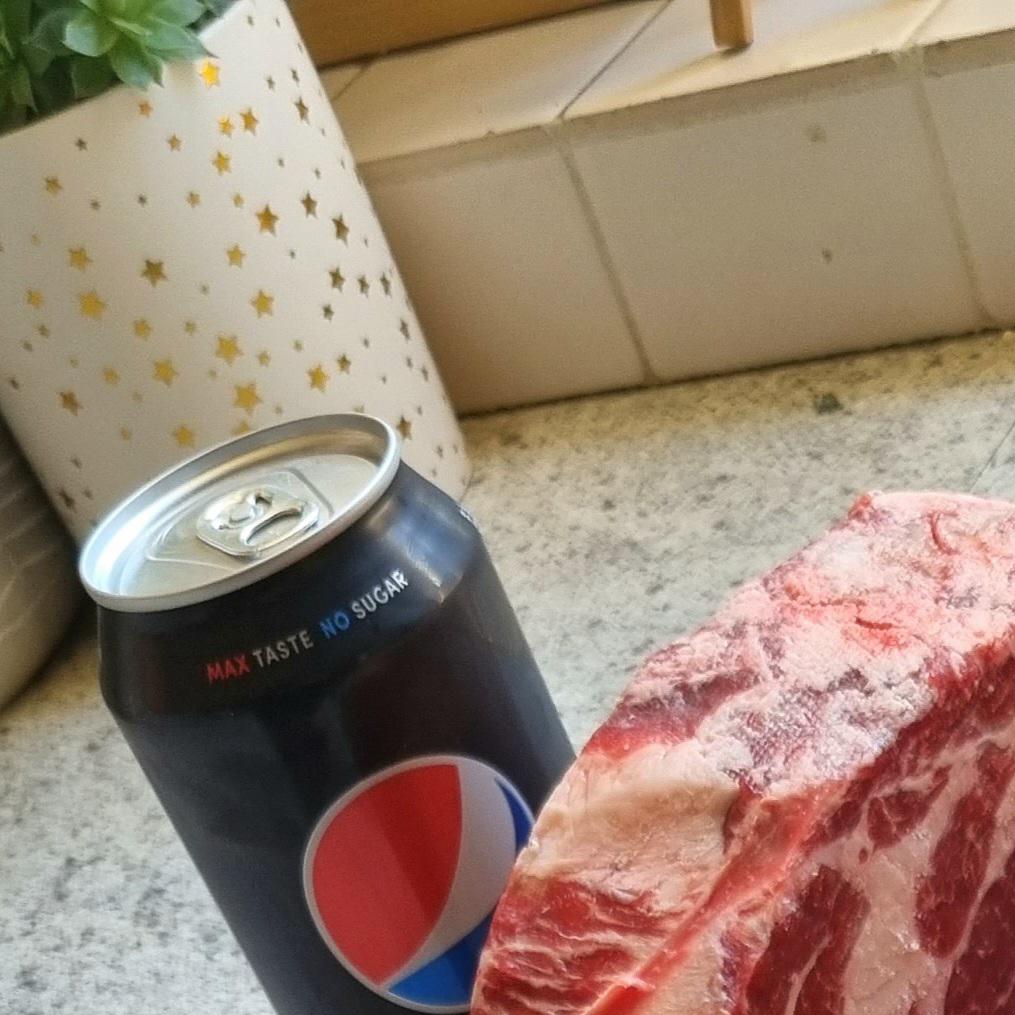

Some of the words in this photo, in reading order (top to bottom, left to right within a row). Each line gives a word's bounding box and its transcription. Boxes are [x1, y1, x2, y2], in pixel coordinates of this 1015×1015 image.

[207, 655, 249, 684] MAX
[252, 630, 314, 668] TASTE
[320, 611, 349, 640] NO
[352, 568, 409, 620] SUGAR
